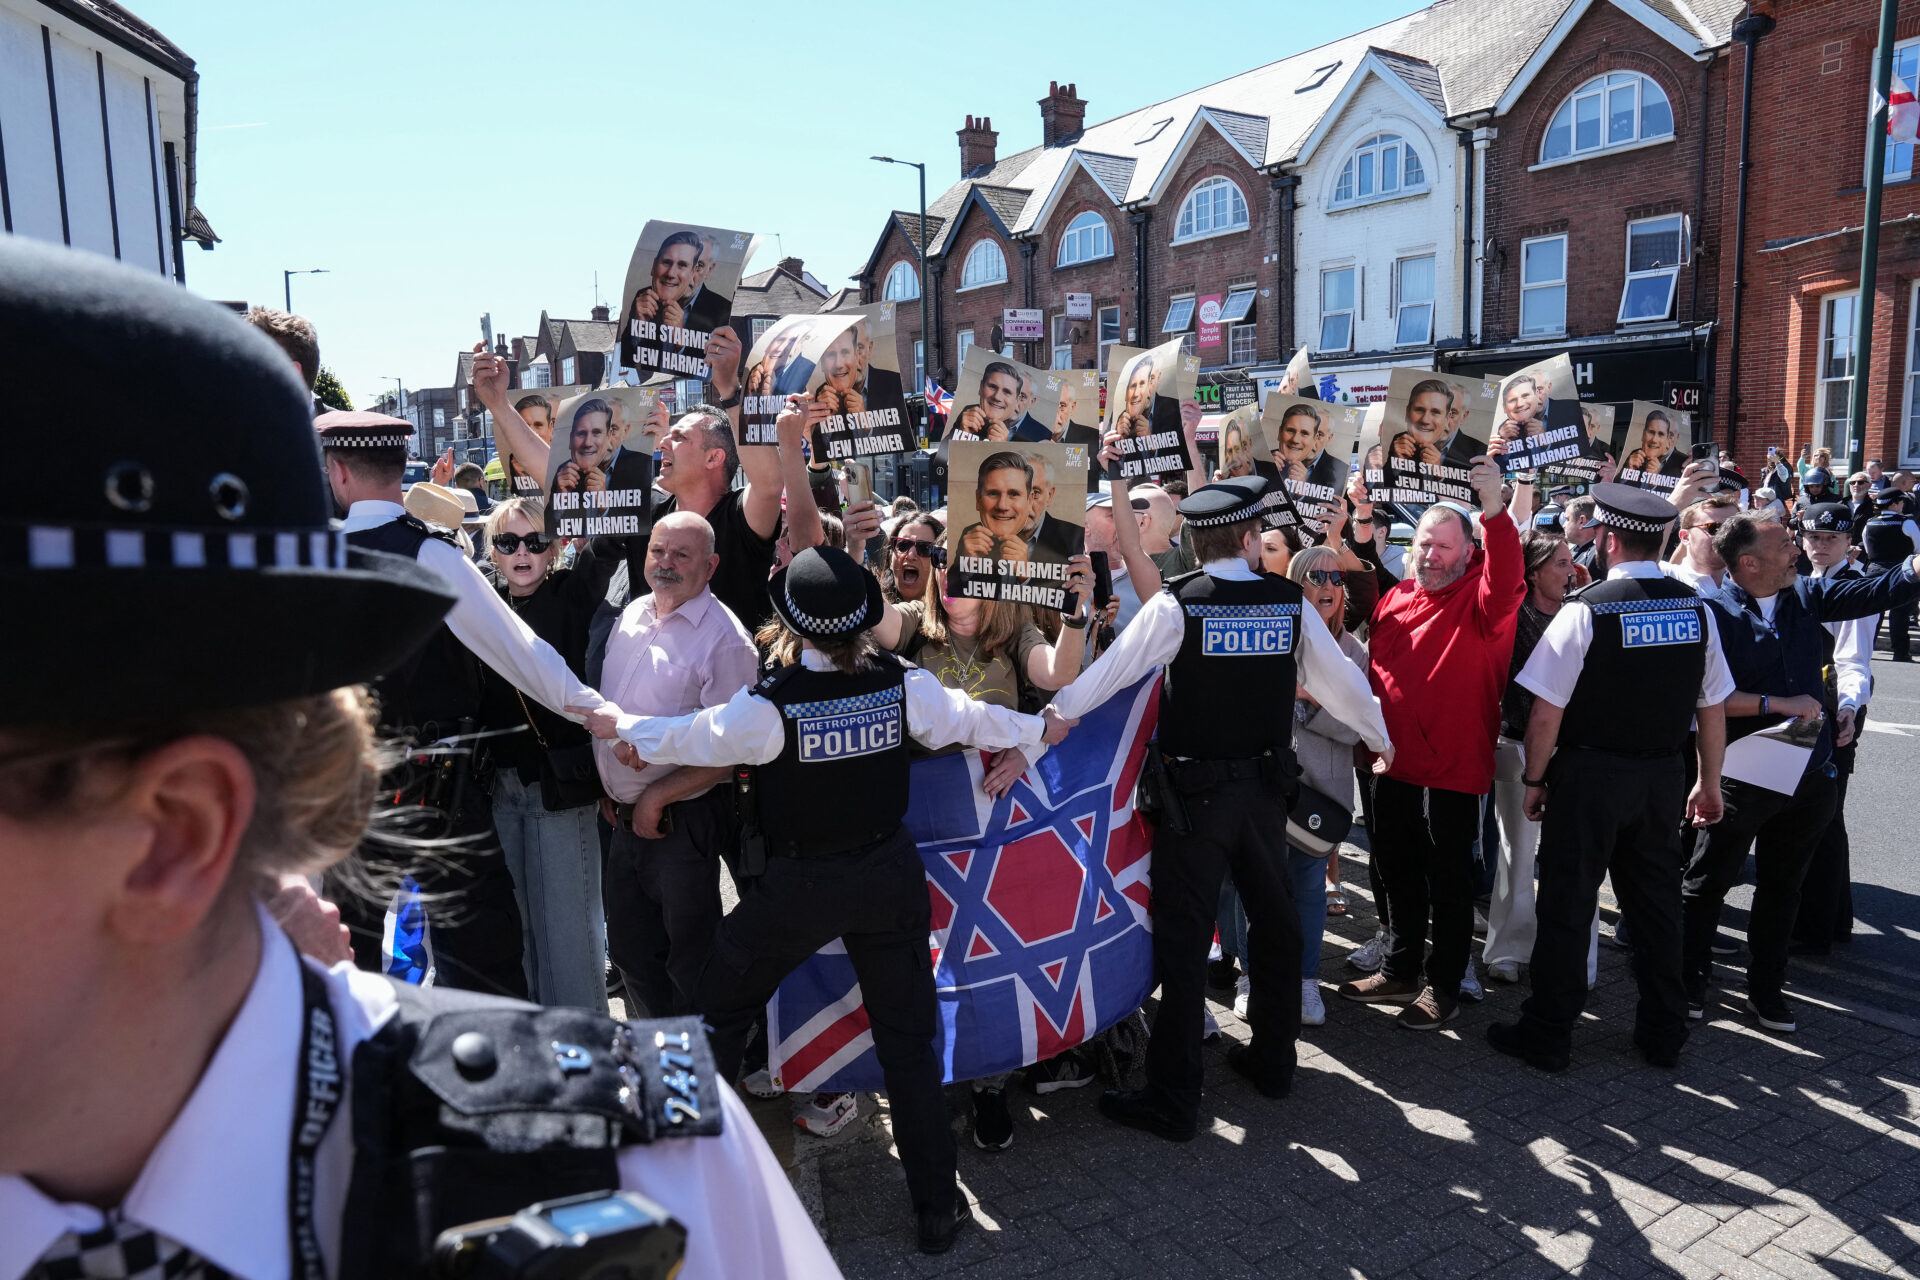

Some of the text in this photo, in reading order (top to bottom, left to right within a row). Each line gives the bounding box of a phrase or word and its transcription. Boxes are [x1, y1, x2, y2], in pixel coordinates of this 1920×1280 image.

[630, 319, 711, 350] KEIR STARME
[633, 346, 709, 378] JEW HARMER
[744, 395, 788, 414] KEIR STARME
[1670, 388, 1699, 410] SACH
[820, 408, 900, 434] KEIR STARMER
[746, 424, 777, 442] JEW HAR
[1137, 431, 1180, 452] STARMER
[1504, 425, 1578, 454] EIR STARMER
[827, 438, 852, 459] JEW
[855, 434, 904, 455] HARMER
[1506, 444, 1580, 470] JEW HARMER
[1120, 454, 1184, 477] JEW HARMER
[1390, 456, 1471, 482] KEIR STARME
[1545, 466, 1596, 480] JEW HARMER
[1566, 458, 1601, 469] STARME
[1621, 468, 1640, 481] KEIR
[553, 492, 579, 510] KEIR
[583, 488, 641, 508] STARMER
[1284, 478, 1335, 501] STARMER
[1369, 489, 1390, 501] JEW
[1395, 476, 1471, 502] JEW HARMER
[557, 515, 639, 536] JEW HARMER
[959, 556, 993, 574] KEIR
[963, 580, 1065, 610] JEW HARMER
[1208, 621, 1290, 629] METROPOLITAN
[1626, 613, 1696, 624] METROPOLITAN
[1207, 630, 1289, 652] POLICE
[1626, 620, 1698, 644] POLICE
[803, 709, 898, 732] METROPOLITAN
[804, 720, 898, 757] POLICE
[300, 1006, 339, 1146] OFFICER
[654, 1031, 701, 1124] 2471
